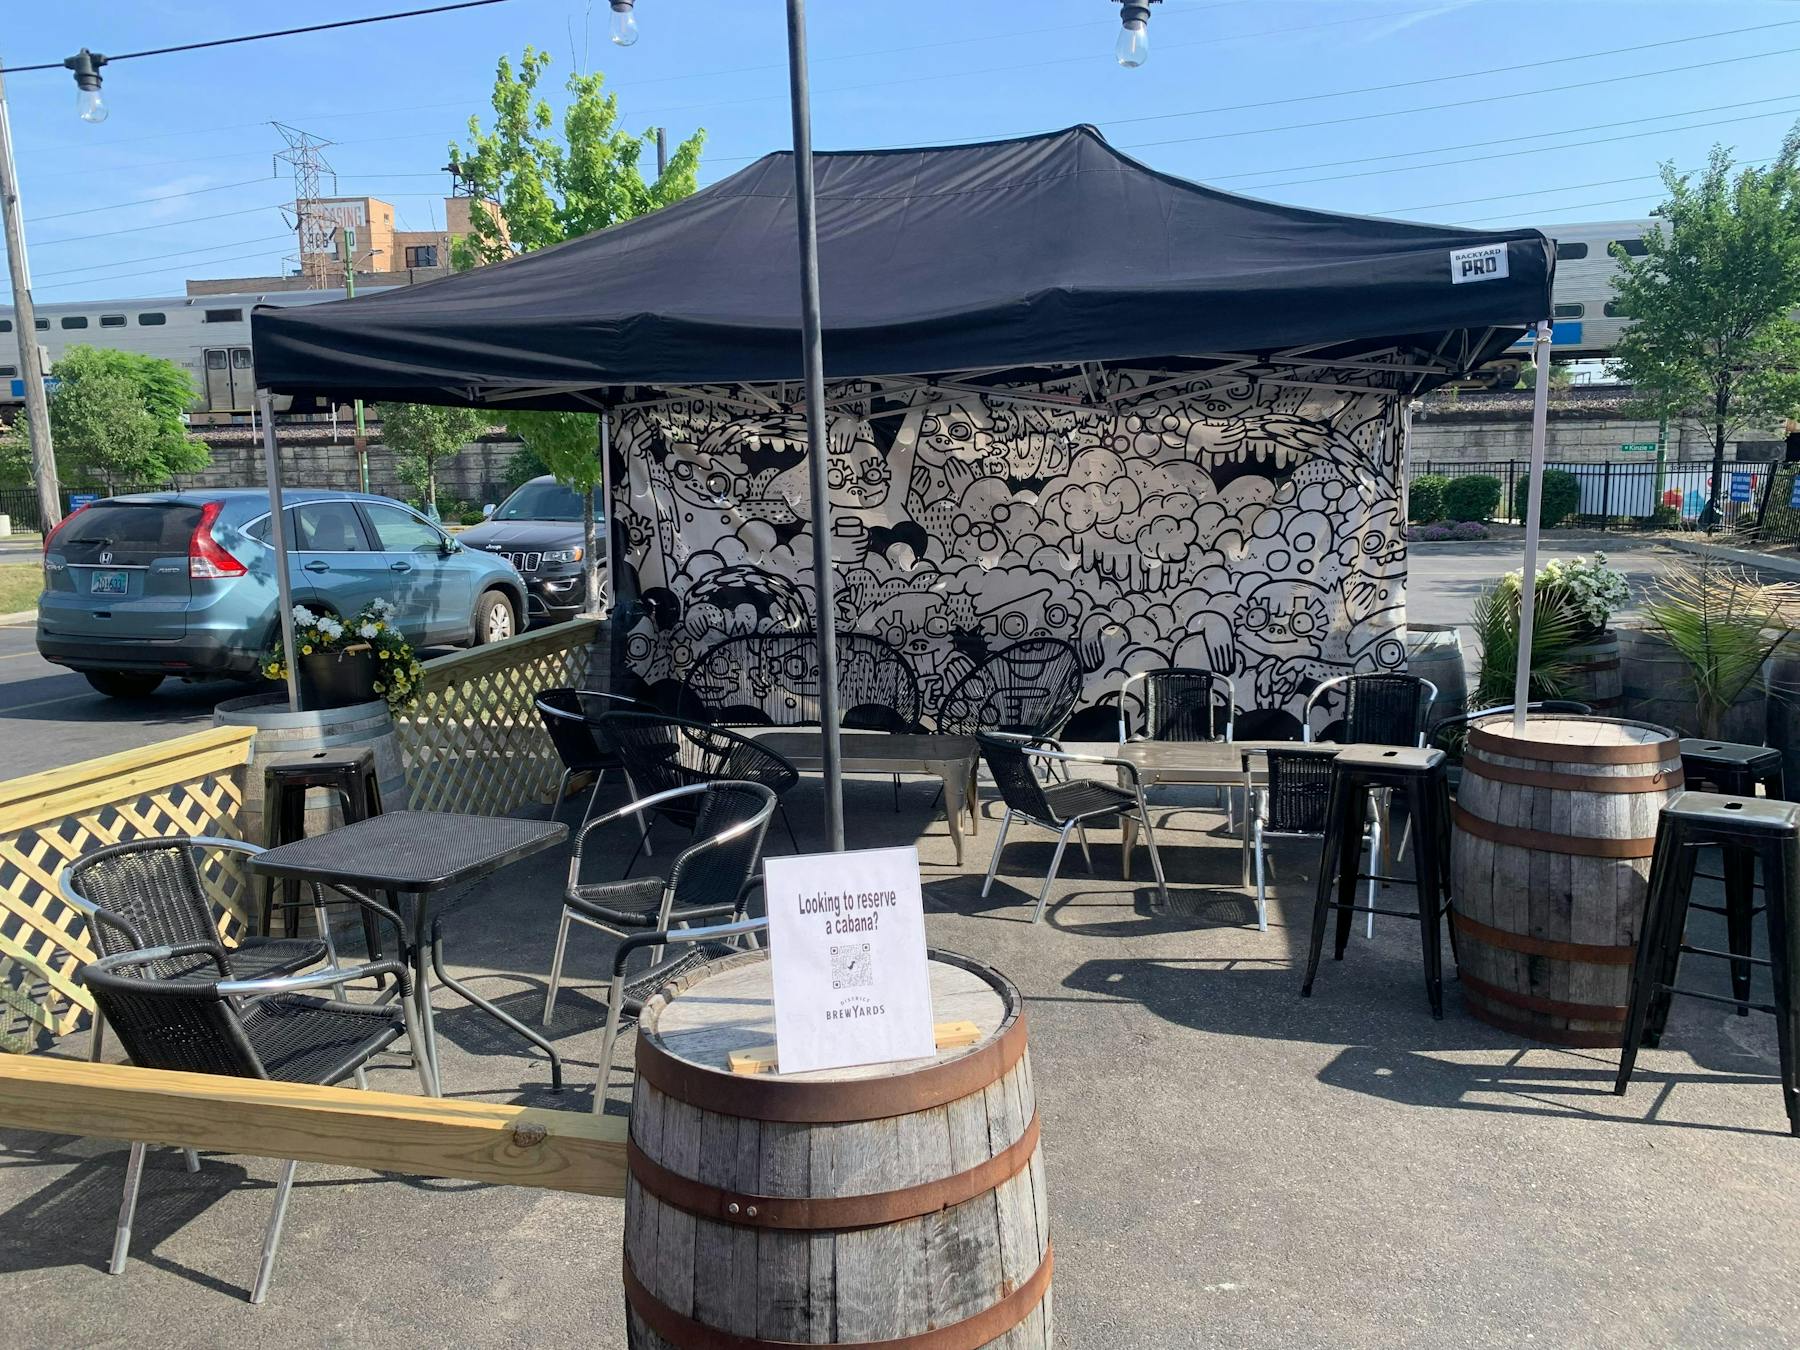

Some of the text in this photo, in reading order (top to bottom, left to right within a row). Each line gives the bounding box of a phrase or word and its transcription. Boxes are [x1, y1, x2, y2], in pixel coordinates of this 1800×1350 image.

[1455, 248, 1501, 261] BACKYARD
[1461, 256, 1497, 277] PRO
[486, 543, 502, 551] Jeep
[798, 889, 897, 917] Looking to reserve
[825, 910, 879, 935] a cabana?
[840, 996, 871, 1006] DISTRICT
[826, 1004, 886, 1021] BREWYARDS
